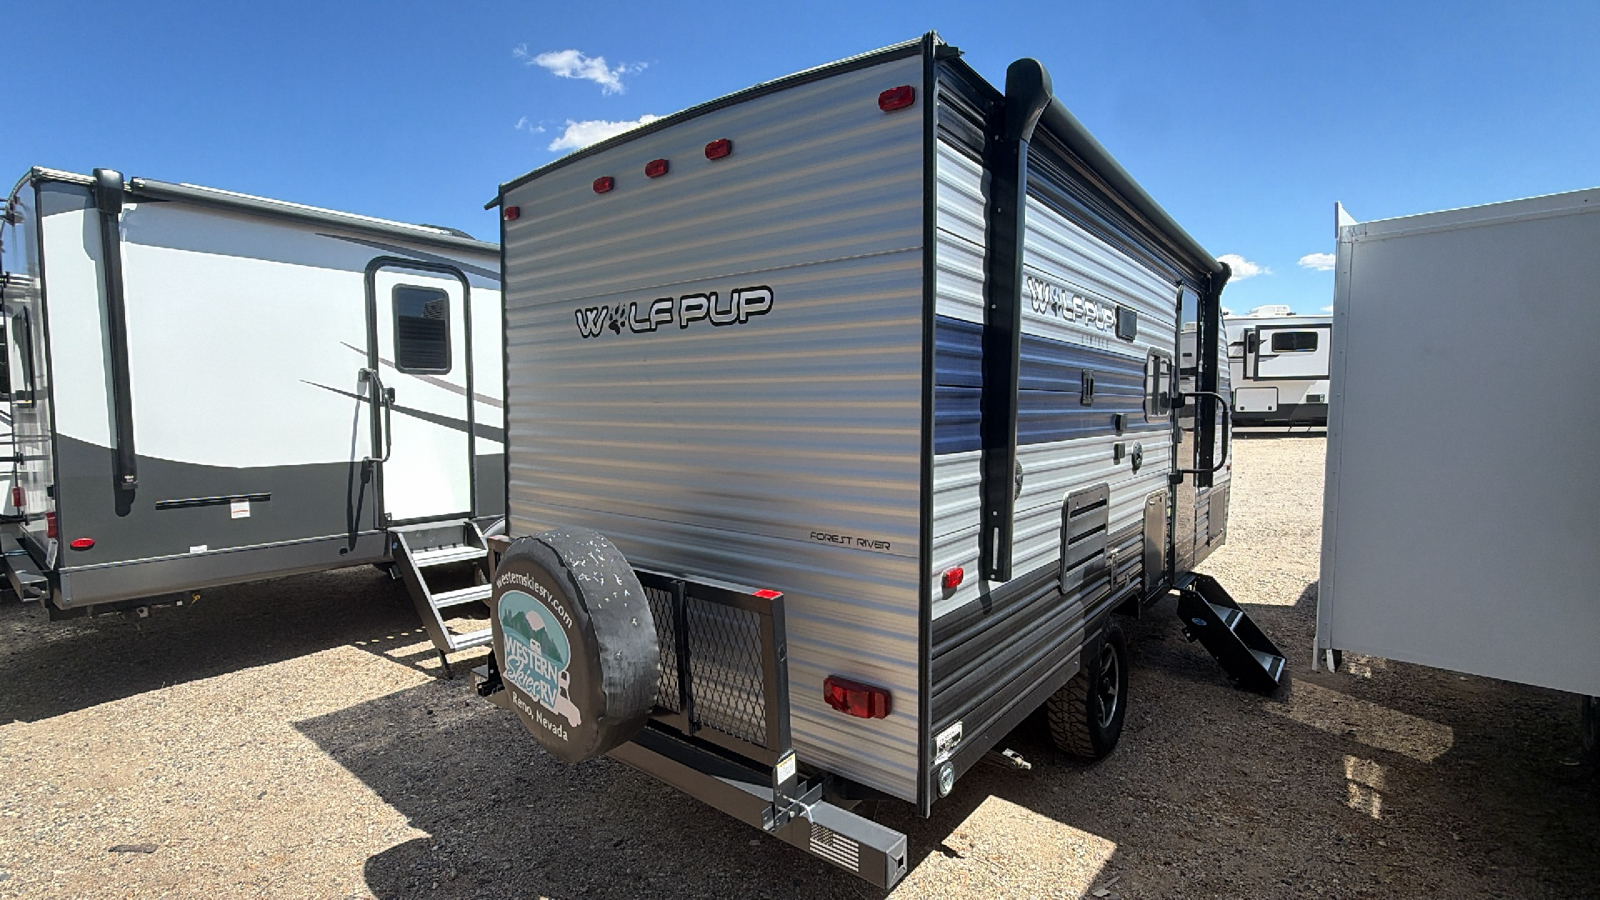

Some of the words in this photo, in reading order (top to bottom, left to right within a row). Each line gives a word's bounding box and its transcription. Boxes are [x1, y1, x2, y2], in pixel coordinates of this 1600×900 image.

[679, 285, 774, 329] PUP
[1084, 298, 1117, 332] PUP
[810, 531, 853, 545] FOREST
[856, 537, 891, 550] RIVER
[496, 571, 573, 629] westernskiesrv.com
[504, 633, 558, 685] WESTERN
[506, 655, 541, 701] Skies
[540, 680, 557, 706] RV
[512, 691, 534, 720] Reno,
[536, 709, 569, 742] Nevada
